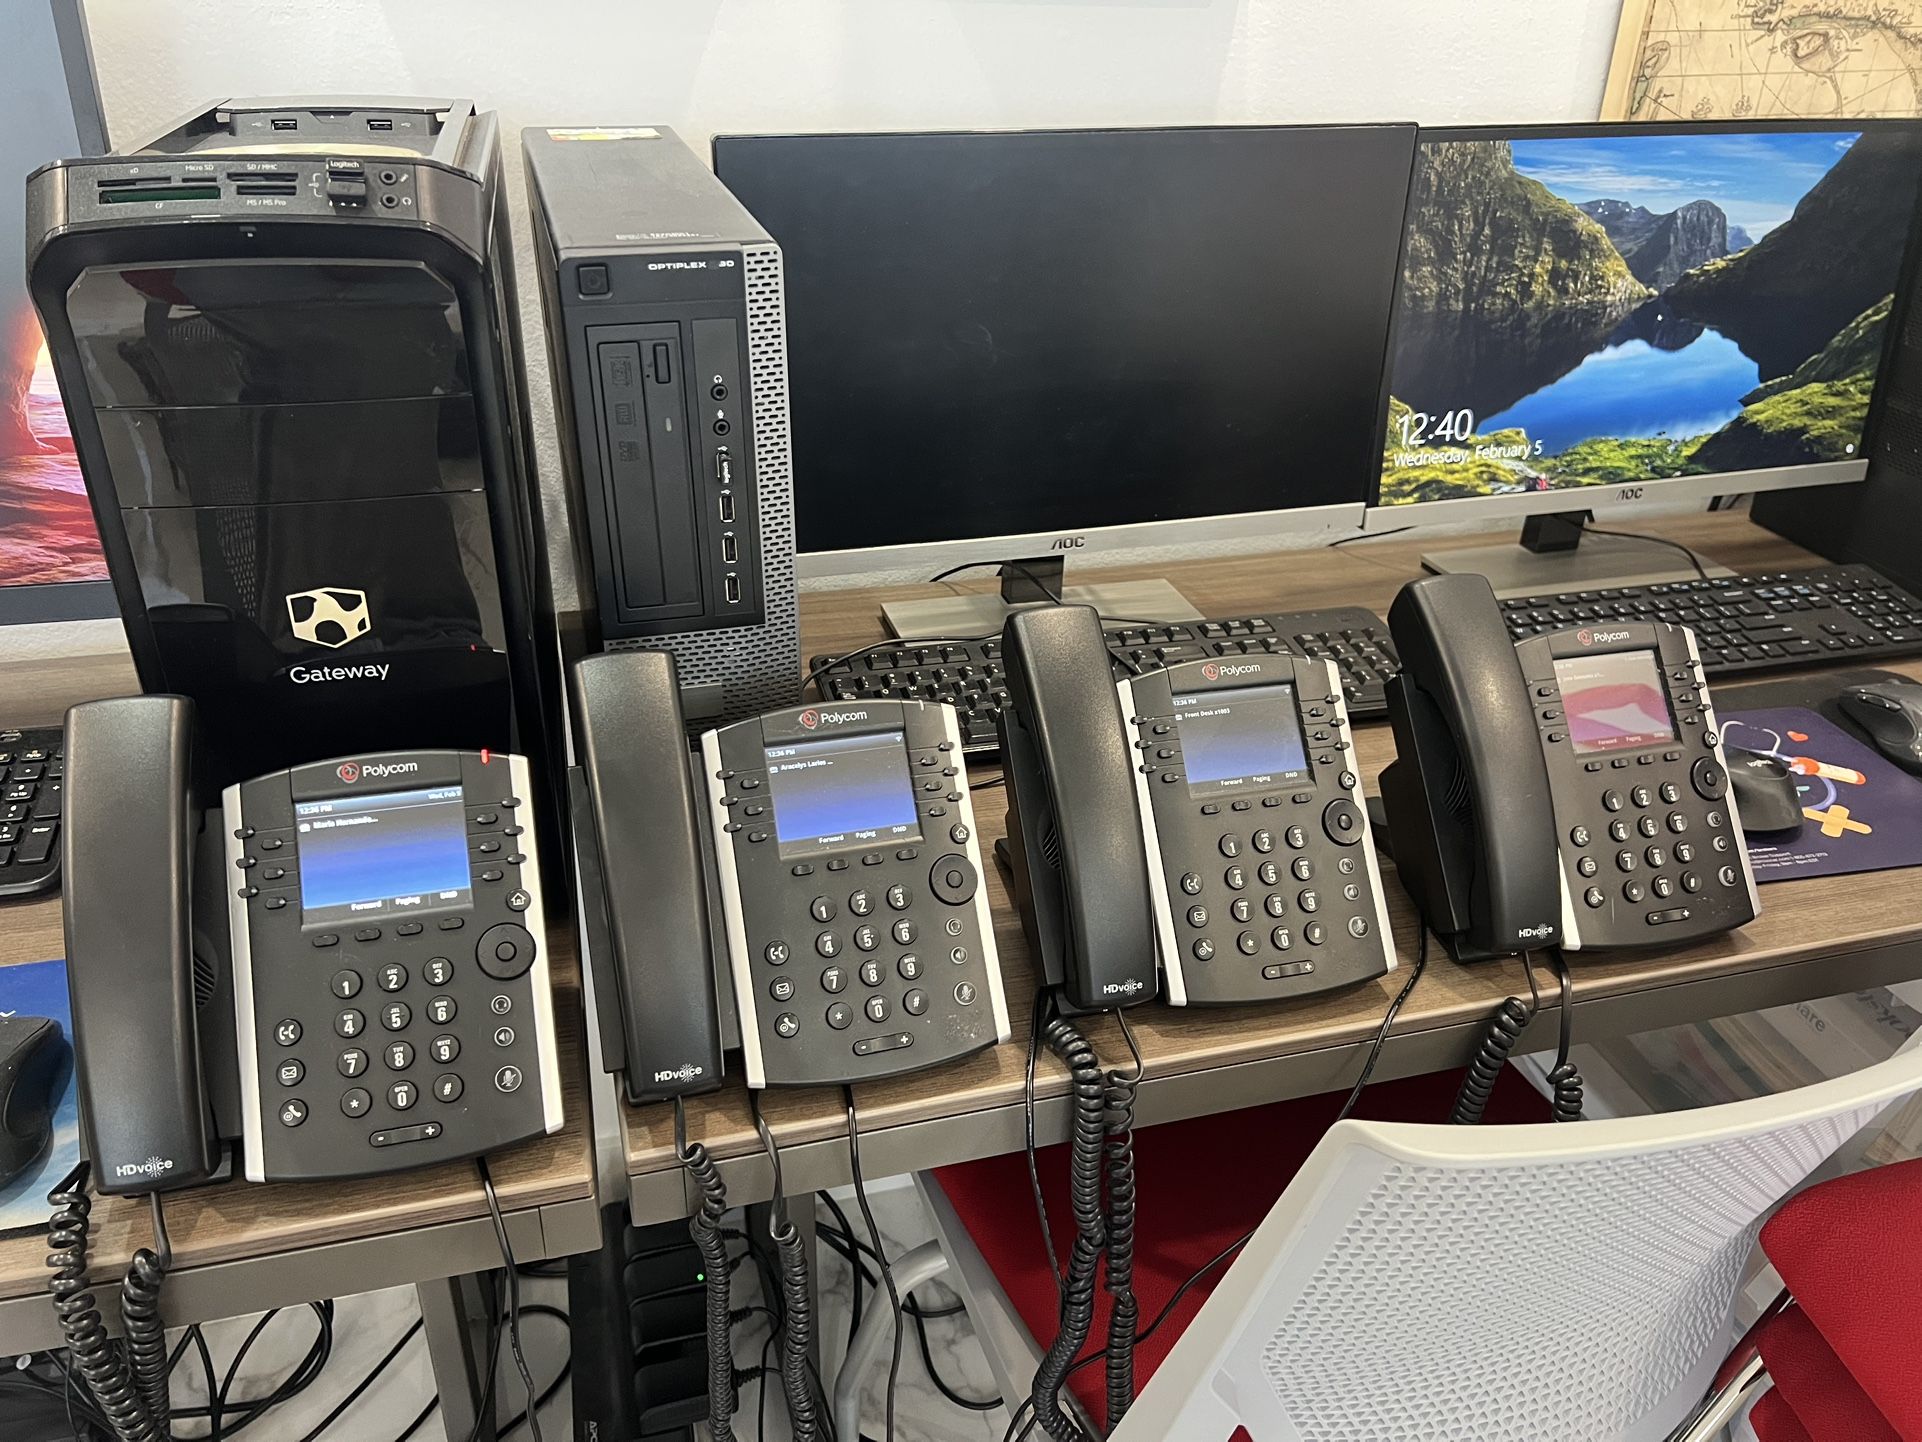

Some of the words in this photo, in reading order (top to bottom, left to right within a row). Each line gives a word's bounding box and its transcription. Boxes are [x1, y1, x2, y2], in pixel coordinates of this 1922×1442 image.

[330, 160, 360, 169] Logitech
[648, 261, 707, 270] OPTIPLEX
[1398, 408, 1474, 446] 12:40
[1394, 450, 1471, 468] Wednesday,
[1475, 444, 1532, 461] February
[1534, 440, 1543, 456] 5
[1616, 488, 1643, 501] AOC
[1051, 536, 1085, 550] AOC
[1593, 630, 1630, 644] Polycom
[290, 664, 390, 684] Gateway
[1220, 664, 1261, 677] Polycom
[821, 710, 868, 726] Polycom
[362, 762, 418, 778] Polycom
[1220, 778, 1243, 786] Forward
[1641, 794, 1649, 806] 2
[1669, 790, 1676, 801] 3
[320, 804, 334, 813] PM
[1612, 798, 1619, 810] 1
[1647, 824, 1654, 836] 5
[1676, 820, 1683, 832] 6
[818, 834, 844, 844] Forward
[856, 830, 876, 839] Paging
[892, 826, 907, 834] DND
[1296, 834, 1303, 845] 3
[1618, 828, 1626, 840] 4
[1229, 842, 1235, 853] 1
[1263, 838, 1271, 849] 2
[1654, 853, 1661, 865] 8
[1682, 850, 1690, 860] 9
[1624, 857, 1630, 868] 7
[1269, 870, 1276, 881] 5
[1302, 866, 1309, 877] 6
[1235, 874, 1243, 886] 4
[1661, 884, 1668, 895] 0
[351, 900, 382, 911] Forward
[395, 896, 421, 906] Paging
[859, 900, 866, 912] 2
[896, 894, 904, 906] 3
[1308, 898, 1316, 909] 9
[820, 906, 827, 918] 1
[1240, 907, 1248, 918] 7
[1275, 902, 1282, 914] 8
[901, 928, 909, 941] 6
[1518, 925, 1553, 938] HDvoice
[864, 934, 872, 947] 5
[1281, 934, 1289, 946] 0
[825, 941, 833, 953] 4
[434, 968, 443, 982] 3
[869, 969, 878, 982] 8
[907, 963, 916, 975] 9
[342, 981, 349, 995] 1
[388, 975, 398, 988] 2
[830, 976, 838, 989] 7
[1103, 980, 1143, 994] HDvoice
[437, 1007, 446, 1021] 6
[875, 1005, 883, 1018] 0
[344, 1020, 354, 1034] 4
[391, 1013, 400, 1028] 5
[440, 1046, 450, 1060] 9
[346, 1059, 356, 1073] 7
[394, 1053, 404, 1067] 8
[654, 1066, 702, 1082] HDvoice
[397, 1092, 406, 1106] 0
[116, 1159, 173, 1177] HDvoice
